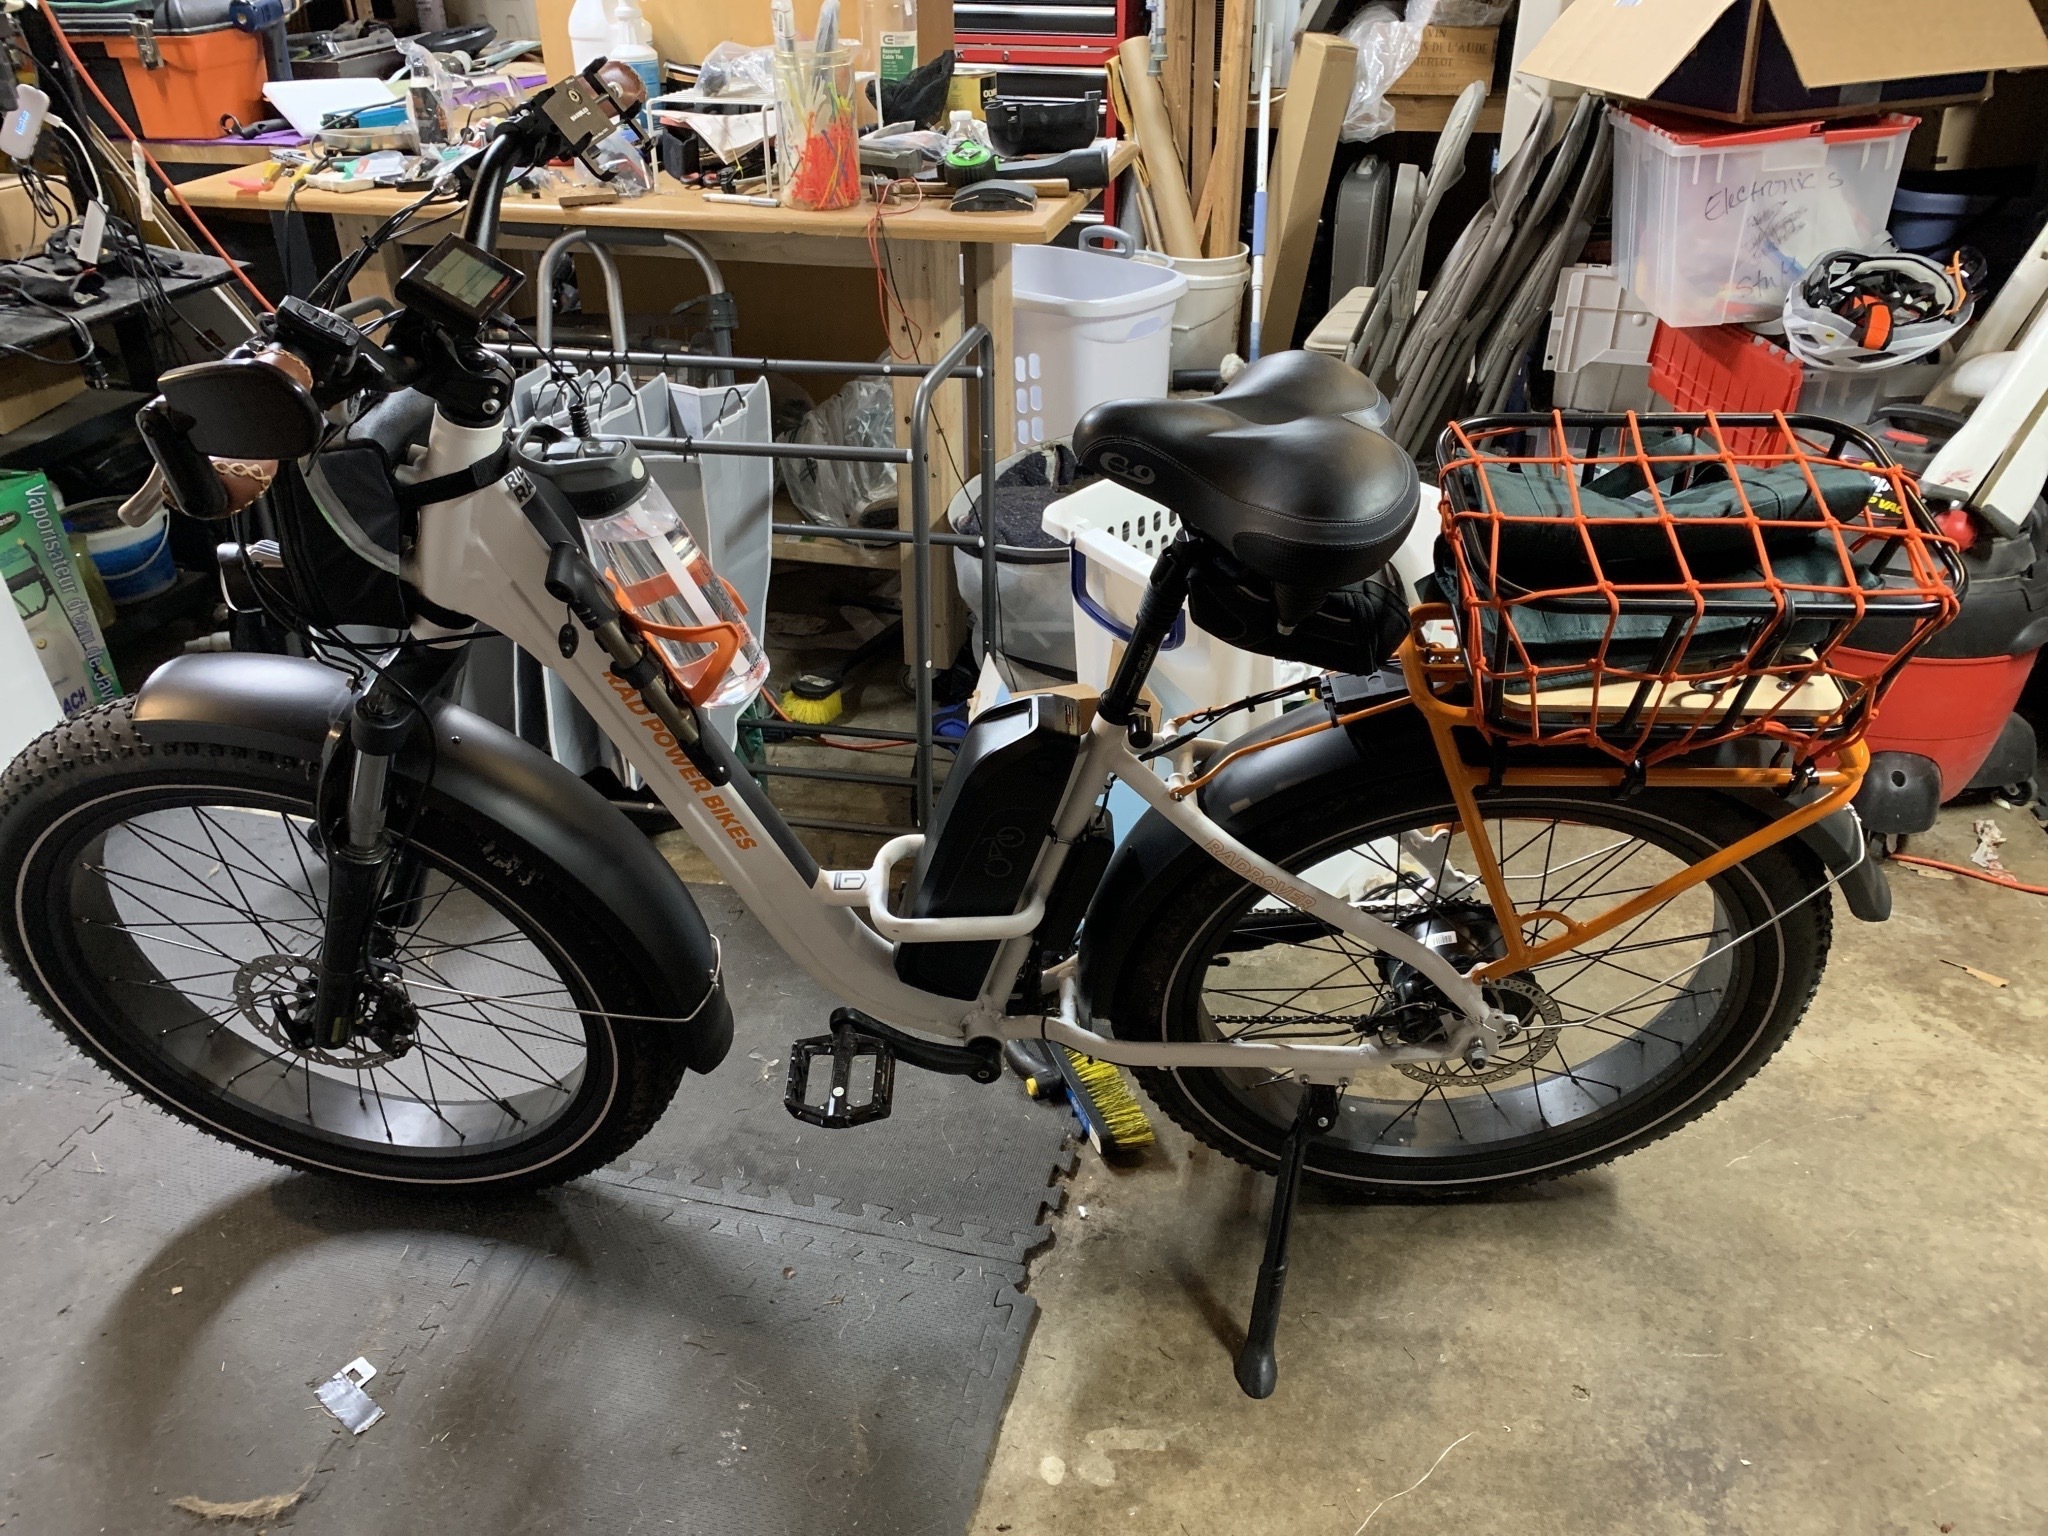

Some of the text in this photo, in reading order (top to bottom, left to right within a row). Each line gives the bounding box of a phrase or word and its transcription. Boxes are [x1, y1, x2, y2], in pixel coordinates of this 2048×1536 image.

[24, 484, 78, 593] Vaporisateur
[66, 597, 97, 643] d'eau
[640, 717, 713, 794] POWER
[701, 794, 758, 850] BIKES
[1203, 838, 1318, 910] RADROVER
